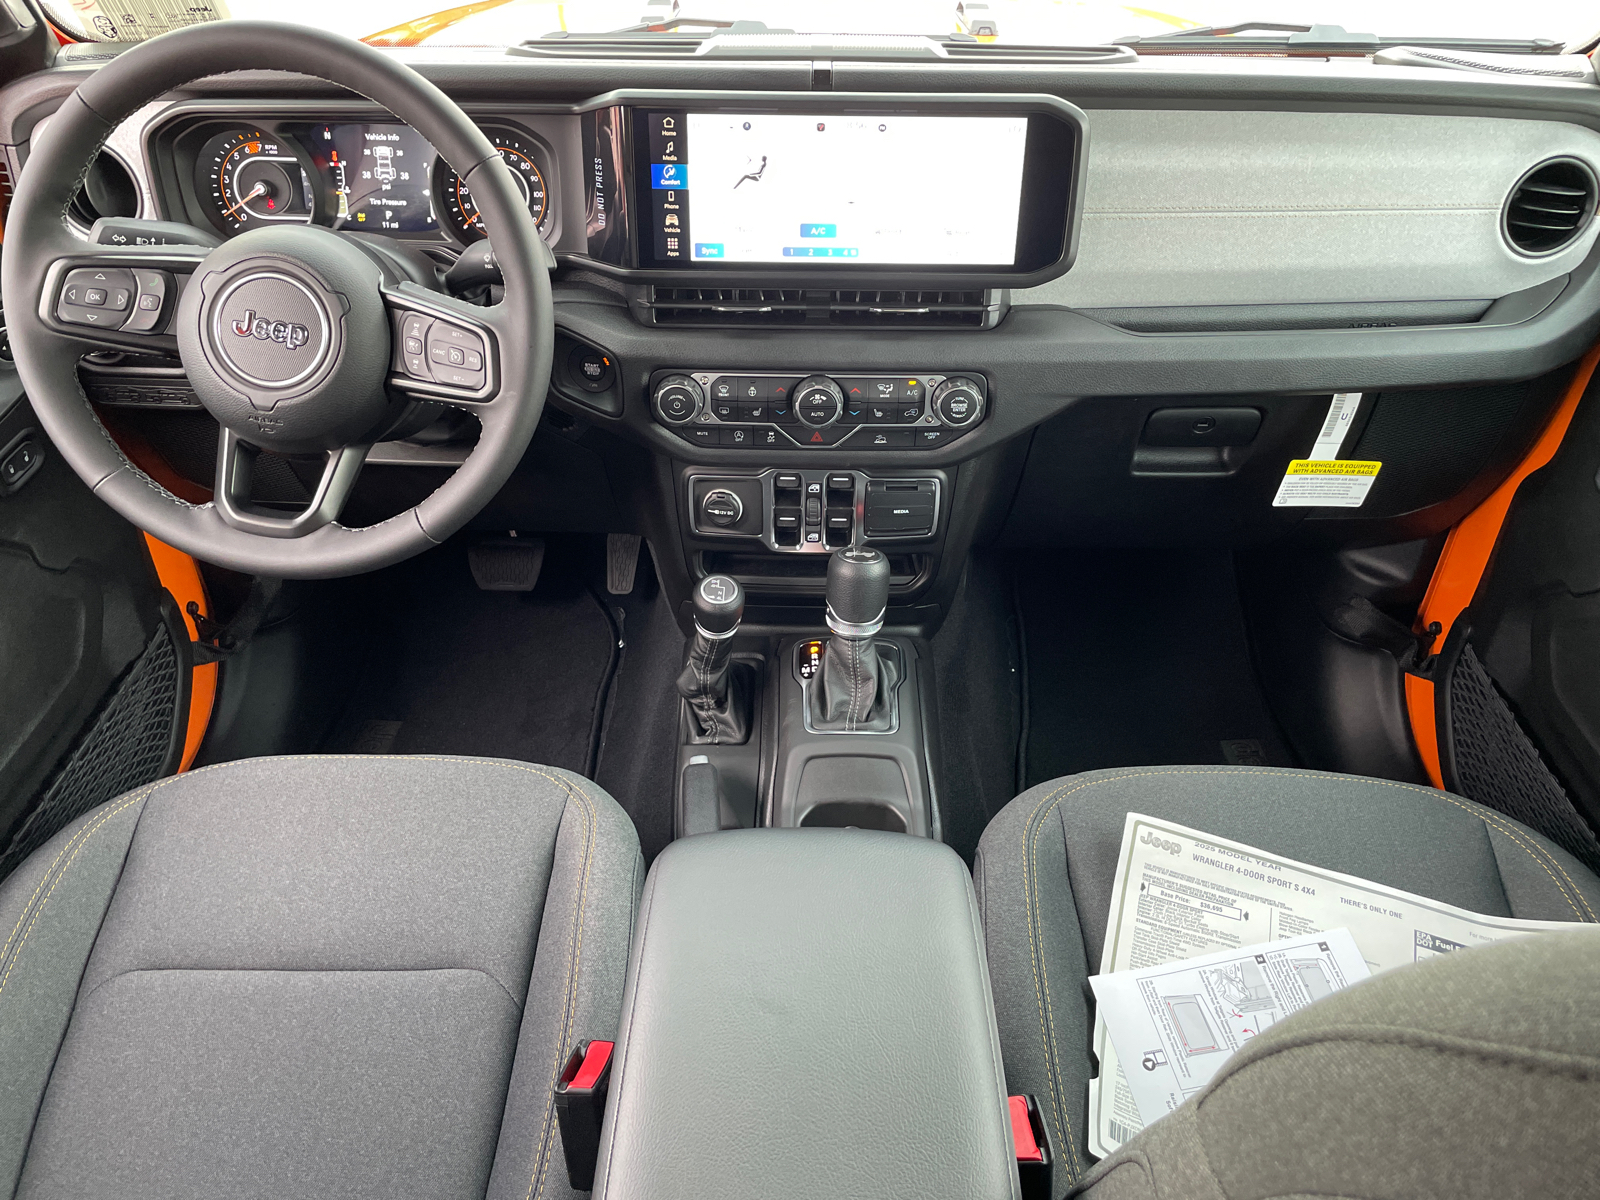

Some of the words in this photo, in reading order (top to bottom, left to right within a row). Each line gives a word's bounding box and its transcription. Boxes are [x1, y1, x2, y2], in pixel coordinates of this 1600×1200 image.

[324, 132, 331, 140] N
[224, 175, 229, 183] 3
[594, 158, 603, 188] PRESS
[596, 191, 604, 210] NOT
[386, 211, 392, 220] P
[598, 213, 605, 226] DO
[701, 247, 718, 256] Sync
[232, 309, 310, 350] Jeep
[1140, 832, 1182, 855] Jeep
[1194, 840, 1215, 851] 2025
[1218, 848, 1251, 862] MODEL
[1255, 858, 1281, 871] YEAR
[1192, 853, 1234, 871] WRANGLER
[1236, 867, 1264, 881] 4-DOOR
[1266, 875, 1292, 888] SPORT
[1301, 886, 1315, 895] 4X4
[1160, 890, 1173, 898] Base
[1174, 894, 1190, 903] Price:
[1340, 896, 1368, 911] THERE'S
[1369, 904, 1388, 915] ONLY
[1389, 909, 1403, 920] ONE
[1417, 931, 1432, 941] EPA
[1416, 939, 1433, 948] DOT
[1436, 940, 1454, 950] Fuel
